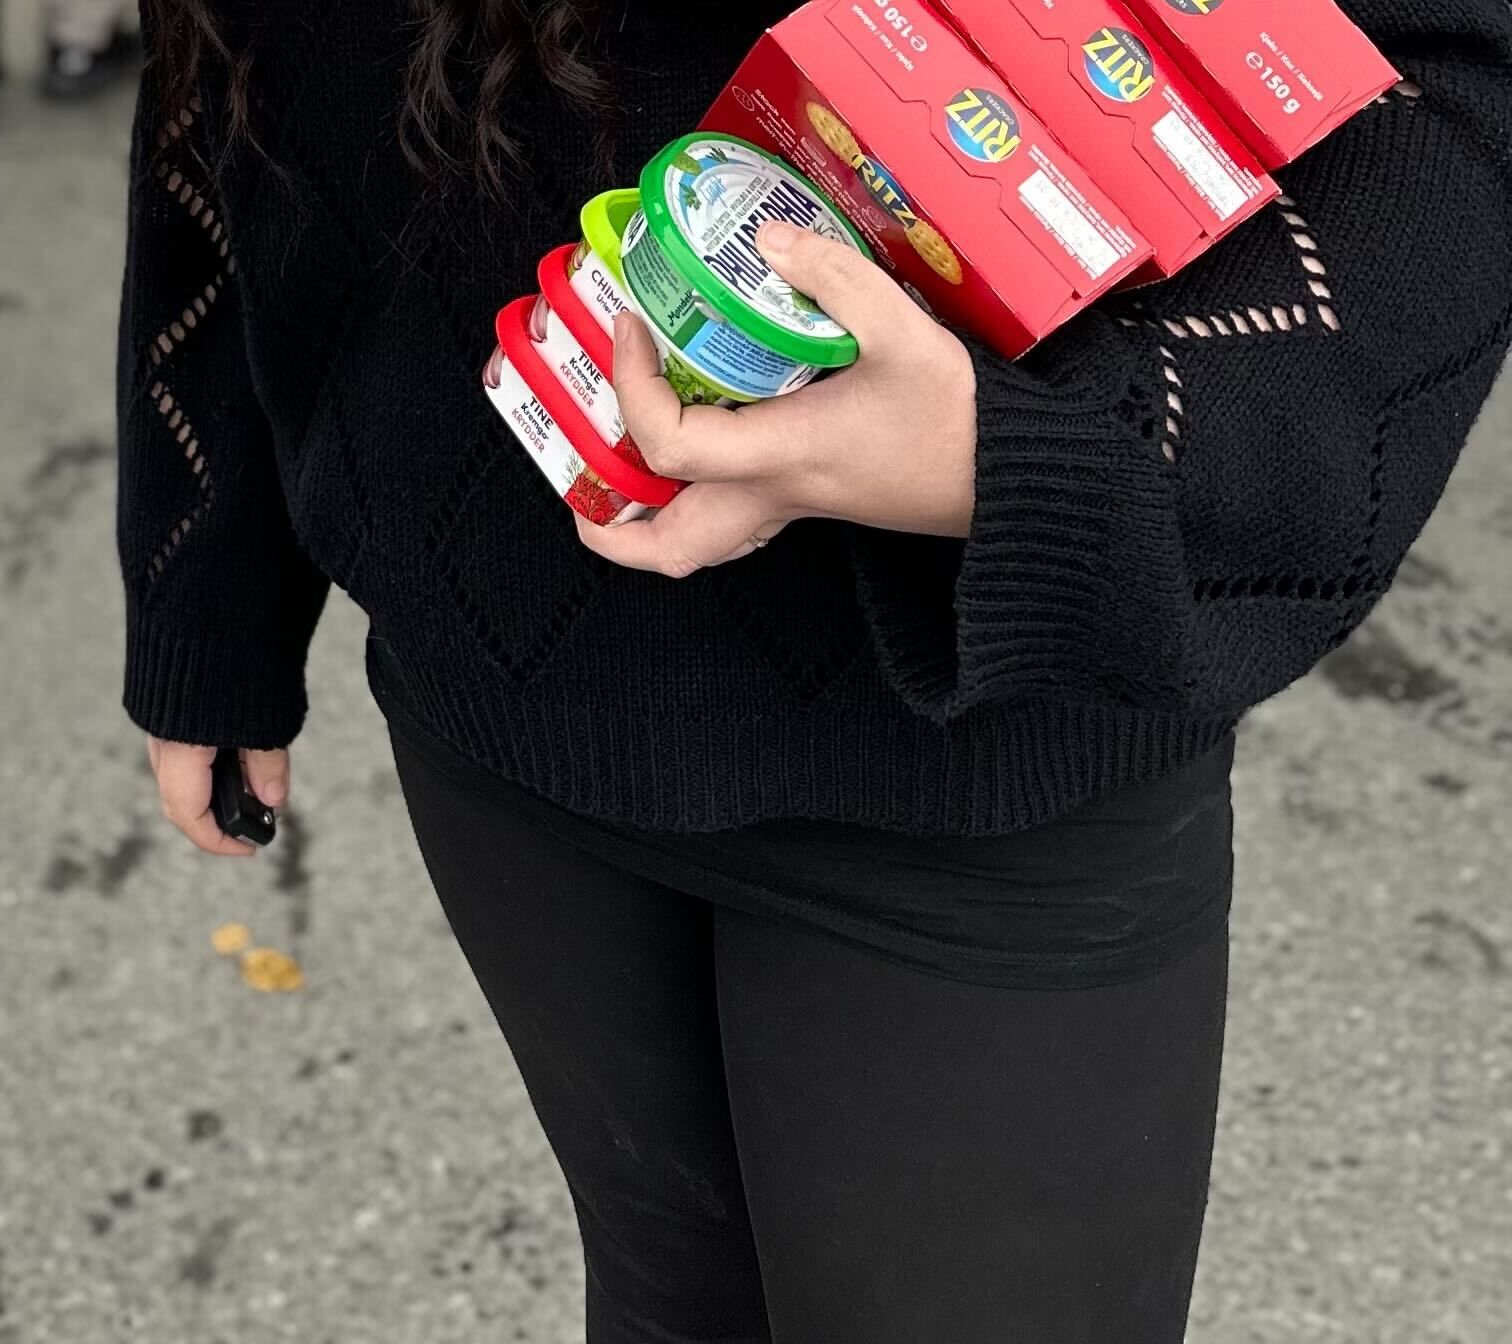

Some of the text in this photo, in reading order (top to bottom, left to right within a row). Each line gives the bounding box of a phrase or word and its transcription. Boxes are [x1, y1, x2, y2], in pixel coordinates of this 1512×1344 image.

[883, 6, 914, 38] 150
[1080, 26, 1157, 103] RITZ
[1122, 33, 1149, 65] CRACKERS
[986, 94, 1015, 125] CRACKERS
[1259, 66, 1301, 114] 150 g
[944, 88, 1021, 163] RITZ
[852, 154, 918, 230] RITZ
[703, 178, 823, 301] PHILAPHIA
[559, 363, 594, 409] KRYDDER
[569, 357, 598, 395] Kremgo
[579, 350, 603, 385] TINE
[511, 408, 545, 454] KRYDDER
[520, 402, 549, 440] Kremgo
[529, 396, 554, 430] TINE
